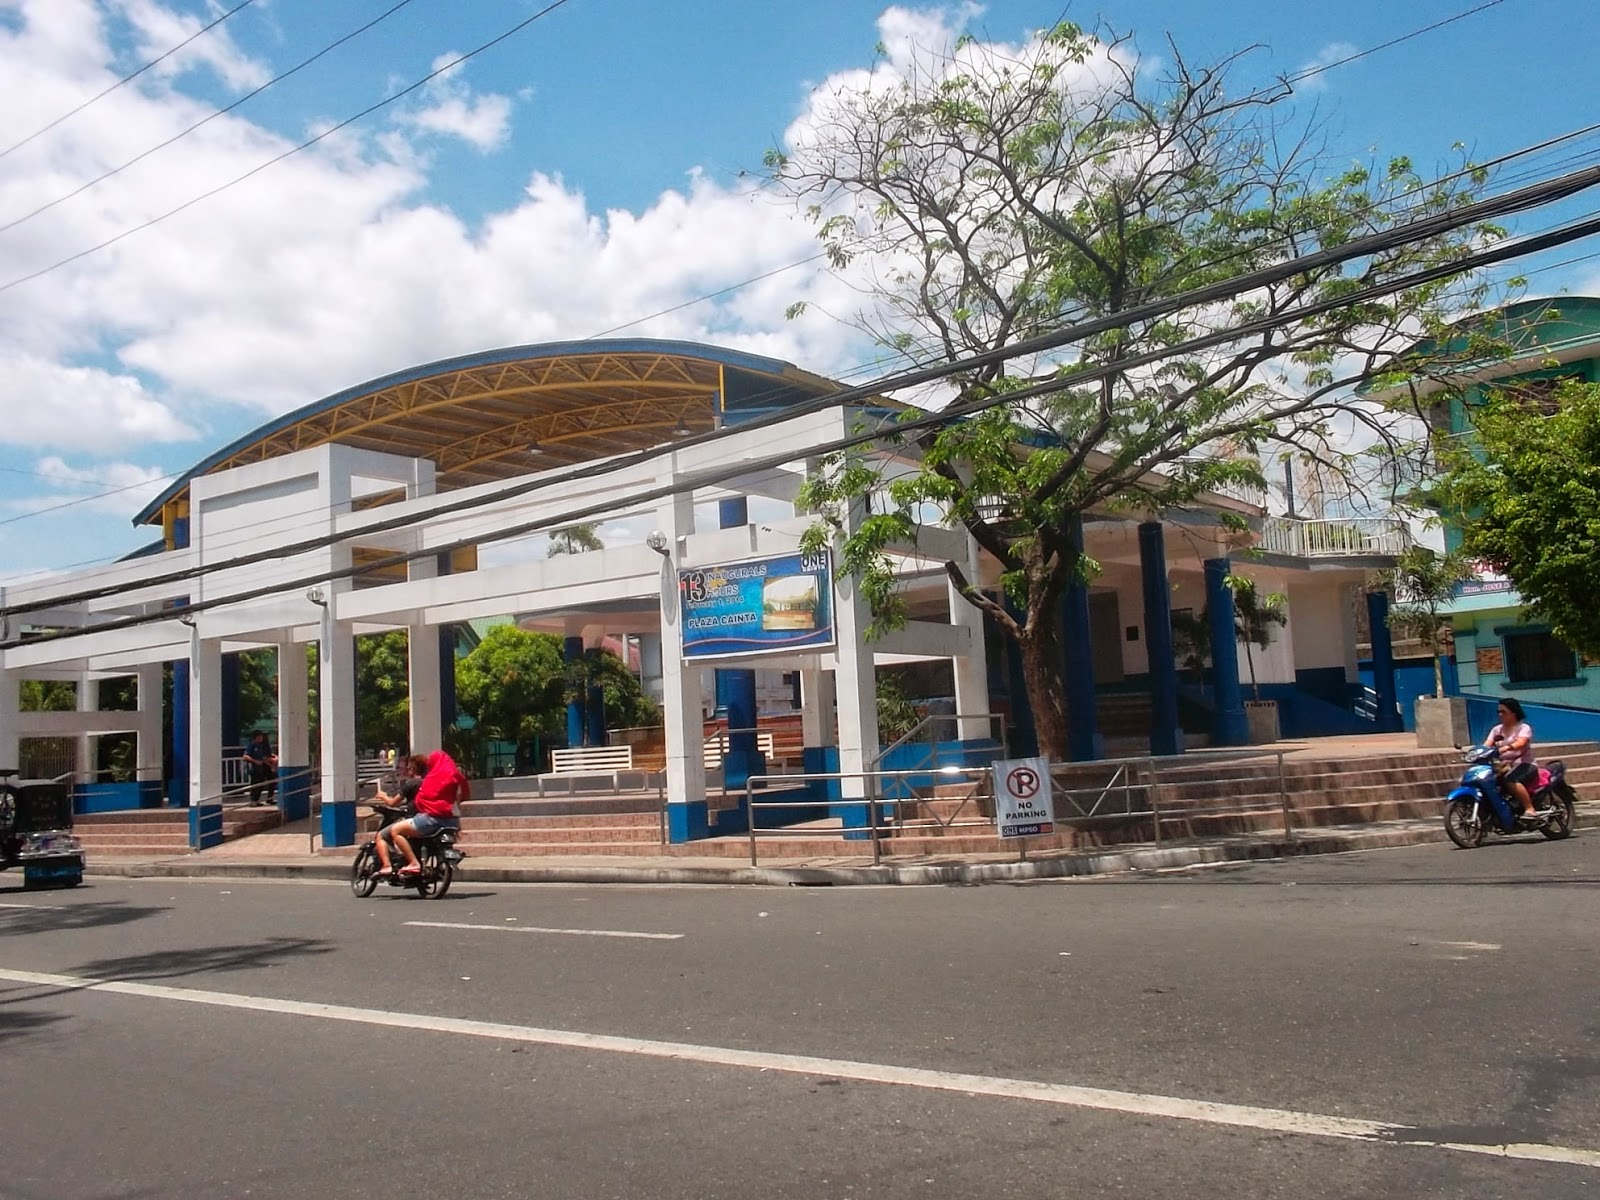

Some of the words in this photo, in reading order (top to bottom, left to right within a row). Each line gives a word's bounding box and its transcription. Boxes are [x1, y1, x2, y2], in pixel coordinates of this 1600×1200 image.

[801, 553, 826, 567] ONE
[706, 565, 767, 581] INAUGURALS
[681, 572, 706, 602] 13
[688, 616, 719, 629] PLAZA
[720, 612, 757, 625] CAINTA
[1006, 810, 1047, 819] PARKING
